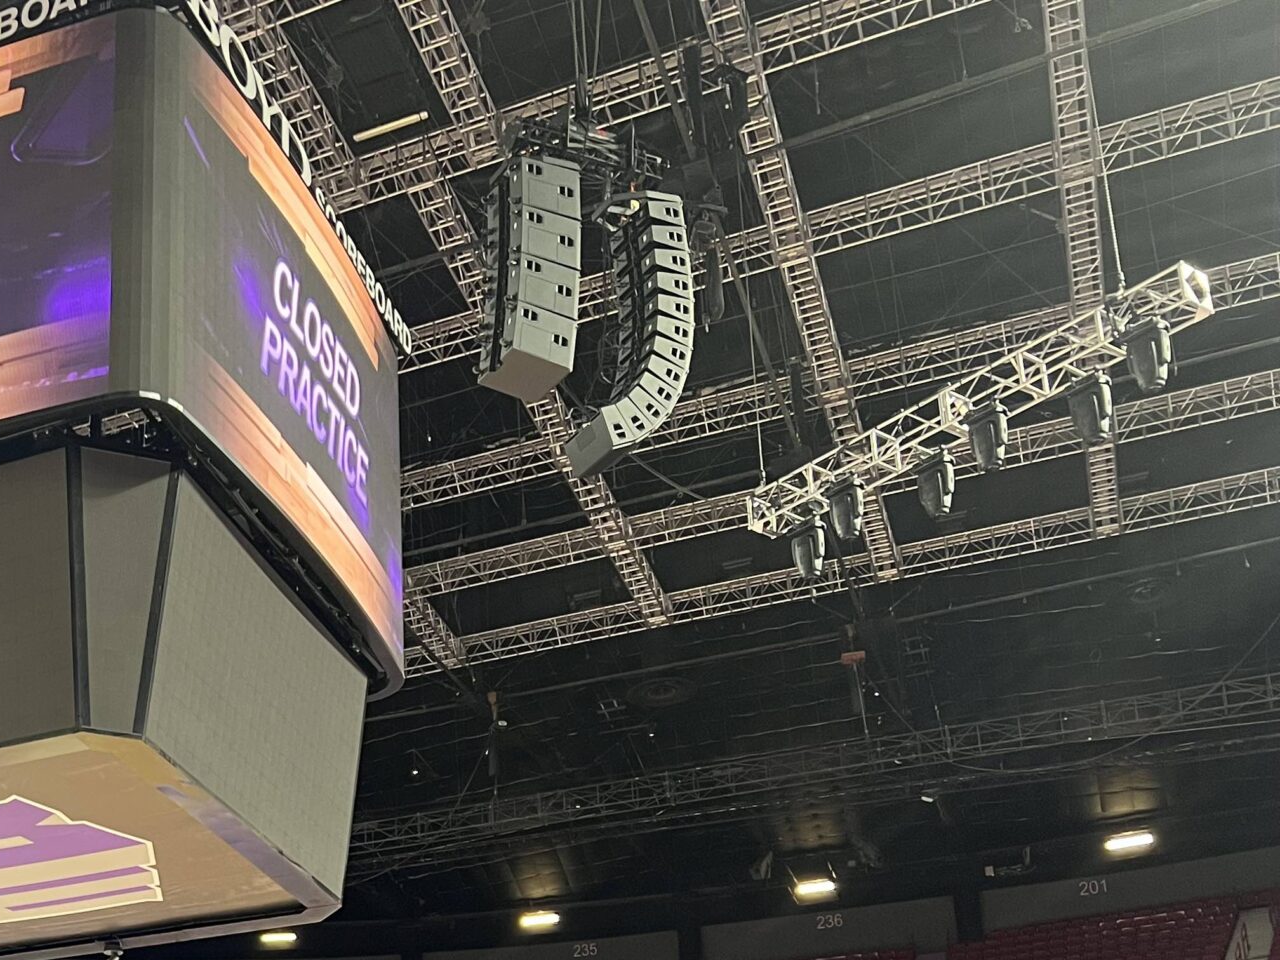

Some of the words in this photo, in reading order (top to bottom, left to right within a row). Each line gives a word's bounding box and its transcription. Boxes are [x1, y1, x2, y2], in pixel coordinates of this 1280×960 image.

[187, 0, 312, 187] BOYD
[274, 261, 360, 417] CLOSED
[261, 317, 369, 506] PRACTICE
[817, 913, 844, 930] 236
[1079, 880, 1108, 896] 201
[574, 943, 598, 958] 235
